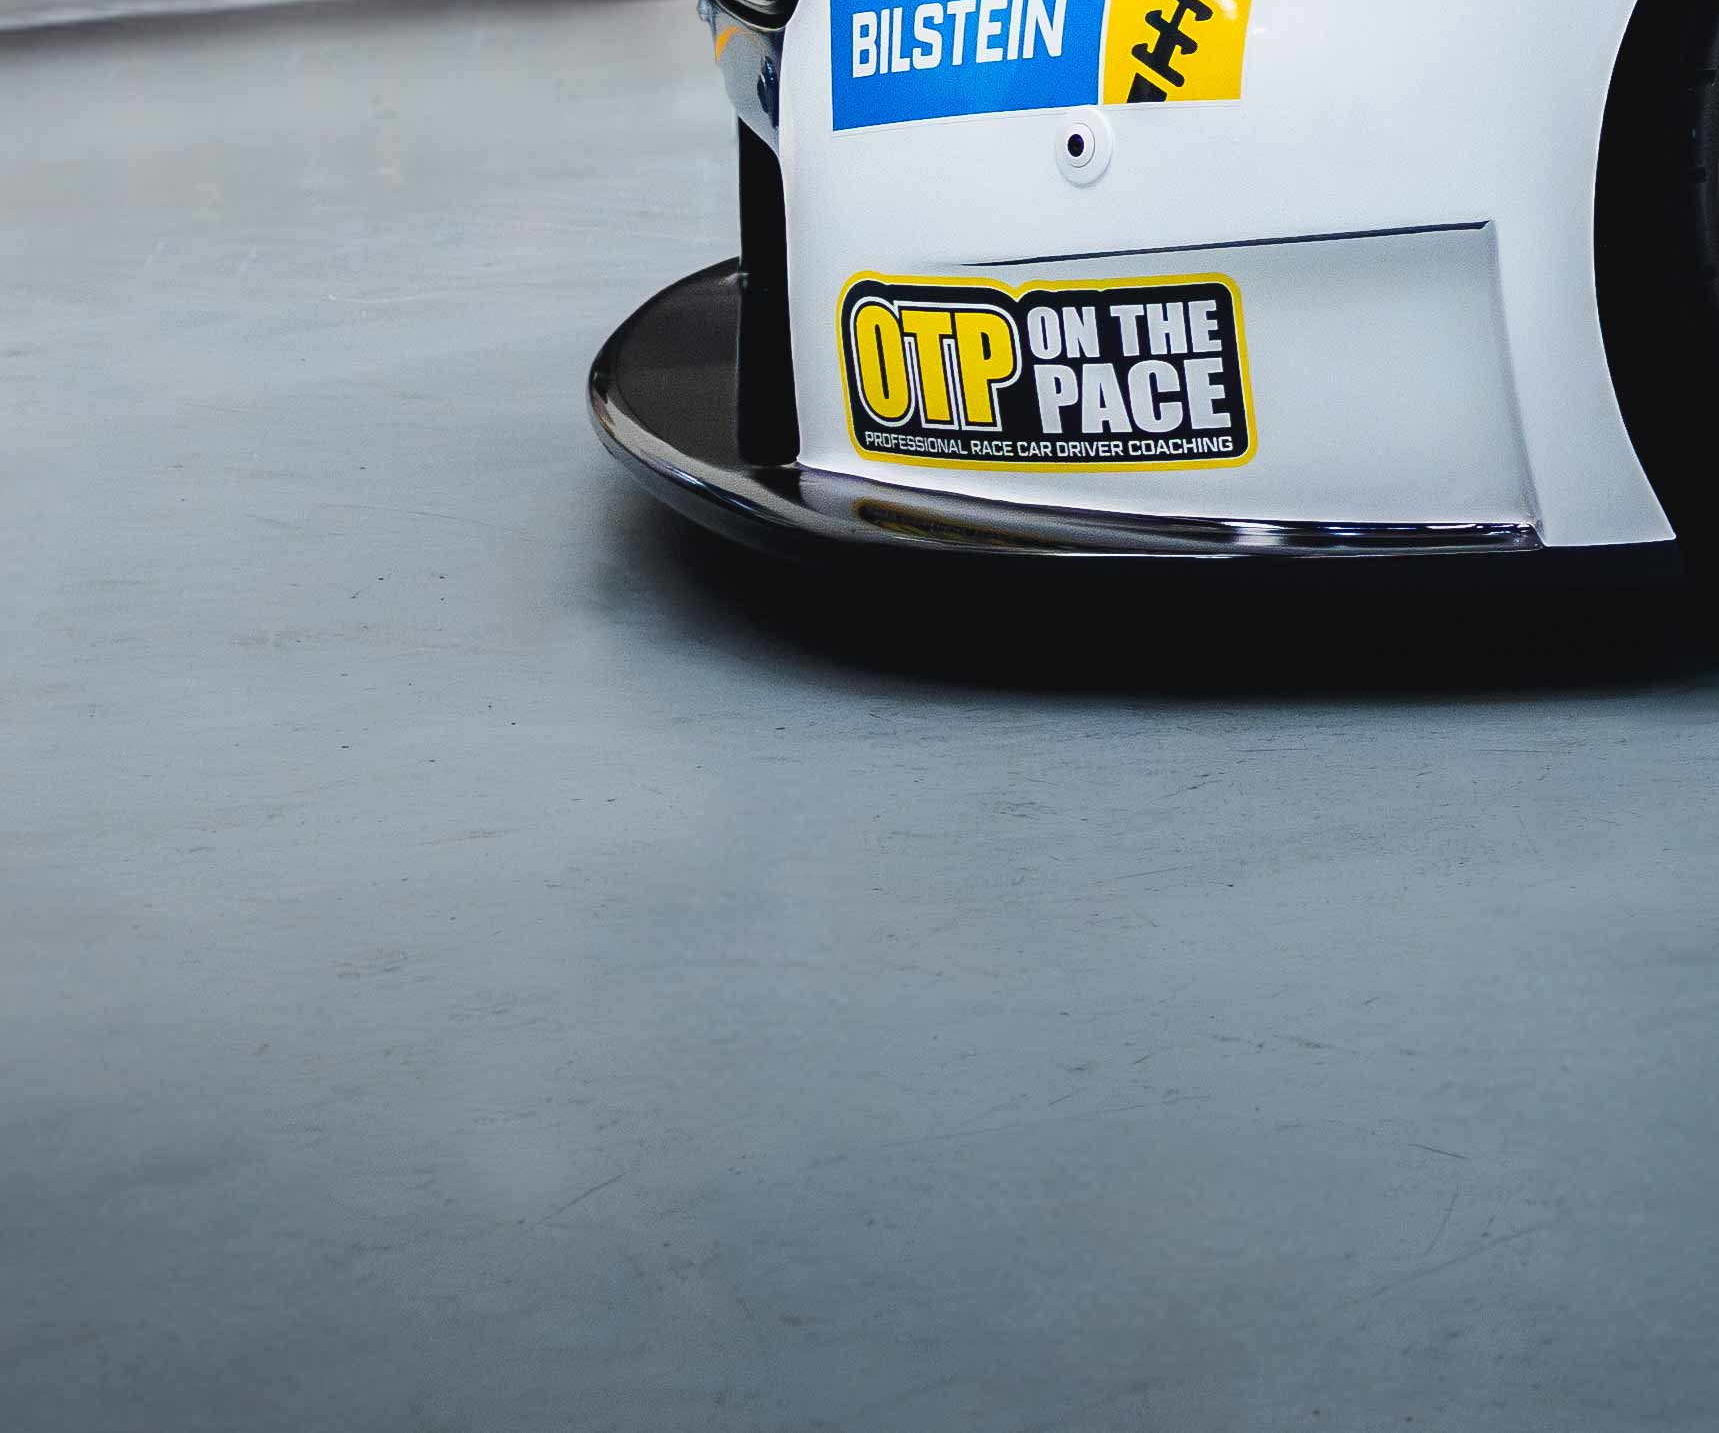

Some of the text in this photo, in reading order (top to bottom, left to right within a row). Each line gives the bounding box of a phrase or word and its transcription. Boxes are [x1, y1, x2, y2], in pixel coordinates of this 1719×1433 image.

[1028, 299, 1222, 360] ON THE
[855, 307, 1015, 427] OTP
[1036, 360, 1231, 435] PACE
[865, 431, 1234, 458] PROFESSIONAL RACE CAR DRIVER COACHING
